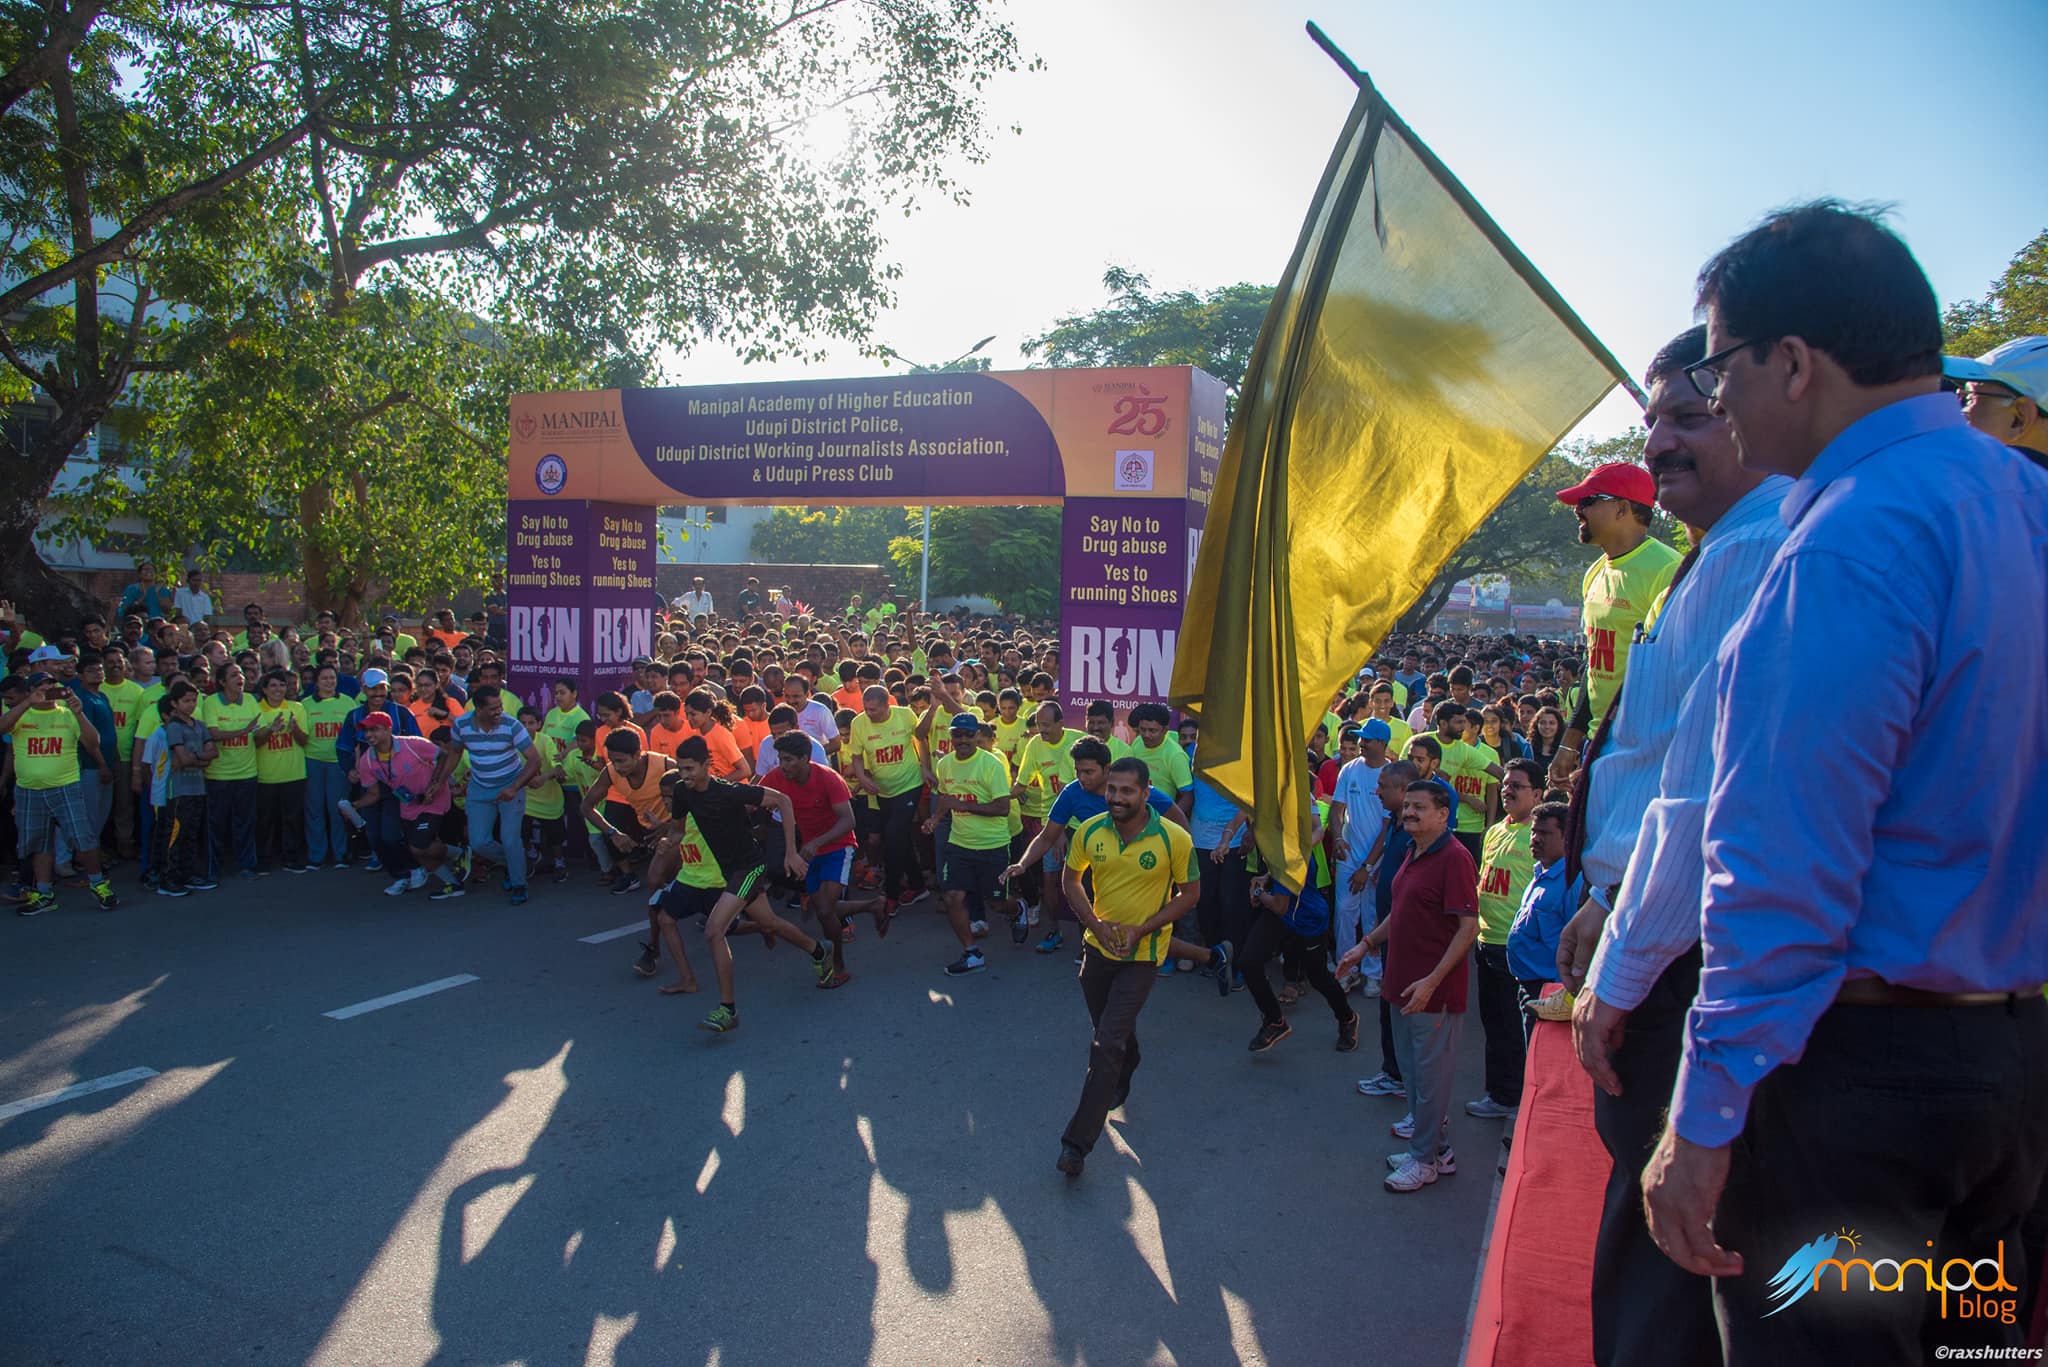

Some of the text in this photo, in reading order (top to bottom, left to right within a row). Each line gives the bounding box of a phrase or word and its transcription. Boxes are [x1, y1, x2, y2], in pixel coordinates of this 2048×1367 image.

[688, 389, 973, 418] Manipal Academy of Higher Education
[540, 410, 621, 429] MANIPAL
[1107, 395, 1168, 435] 25
[746, 416, 904, 438] Udupi District Police,
[656, 437, 1010, 465] Udupi District Working Journalists Association,
[752, 464, 893, 485] & Udupi Press Club
[522, 515, 569, 531] Say No to
[604, 516, 643, 534] Say No to
[1090, 515, 1160, 536] Say No to
[516, 532, 574, 549] Drug abuse
[600, 533, 647, 550] Drug abuse
[1082, 535, 1167, 557] Drug abuse
[531, 555, 561, 569] Yes to
[612, 556, 637, 571] Yes to
[509, 572, 581, 588] running Shoes
[593, 574, 653, 590] running Shoes
[1104, 563, 1148, 582] Yes to
[1070, 585, 1178, 605] running Shoes
[510, 606, 580, 664] RUN
[593, 607, 651, 664] RUN
[511, 664, 579, 675] AGAINST DRUG ABUSE
[594, 666, 616, 675] AGAINST
[1069, 625, 1176, 698] RUN
[1112, 699, 1139, 709] DRUG
[315, 722, 343, 737] RUN
[27, 737, 63, 755] RUN
[268, 732, 293, 750] RUN
[876, 745, 904, 764] RUN
[1455, 775, 1482, 795] RUN
[680, 843, 702, 863] UN
